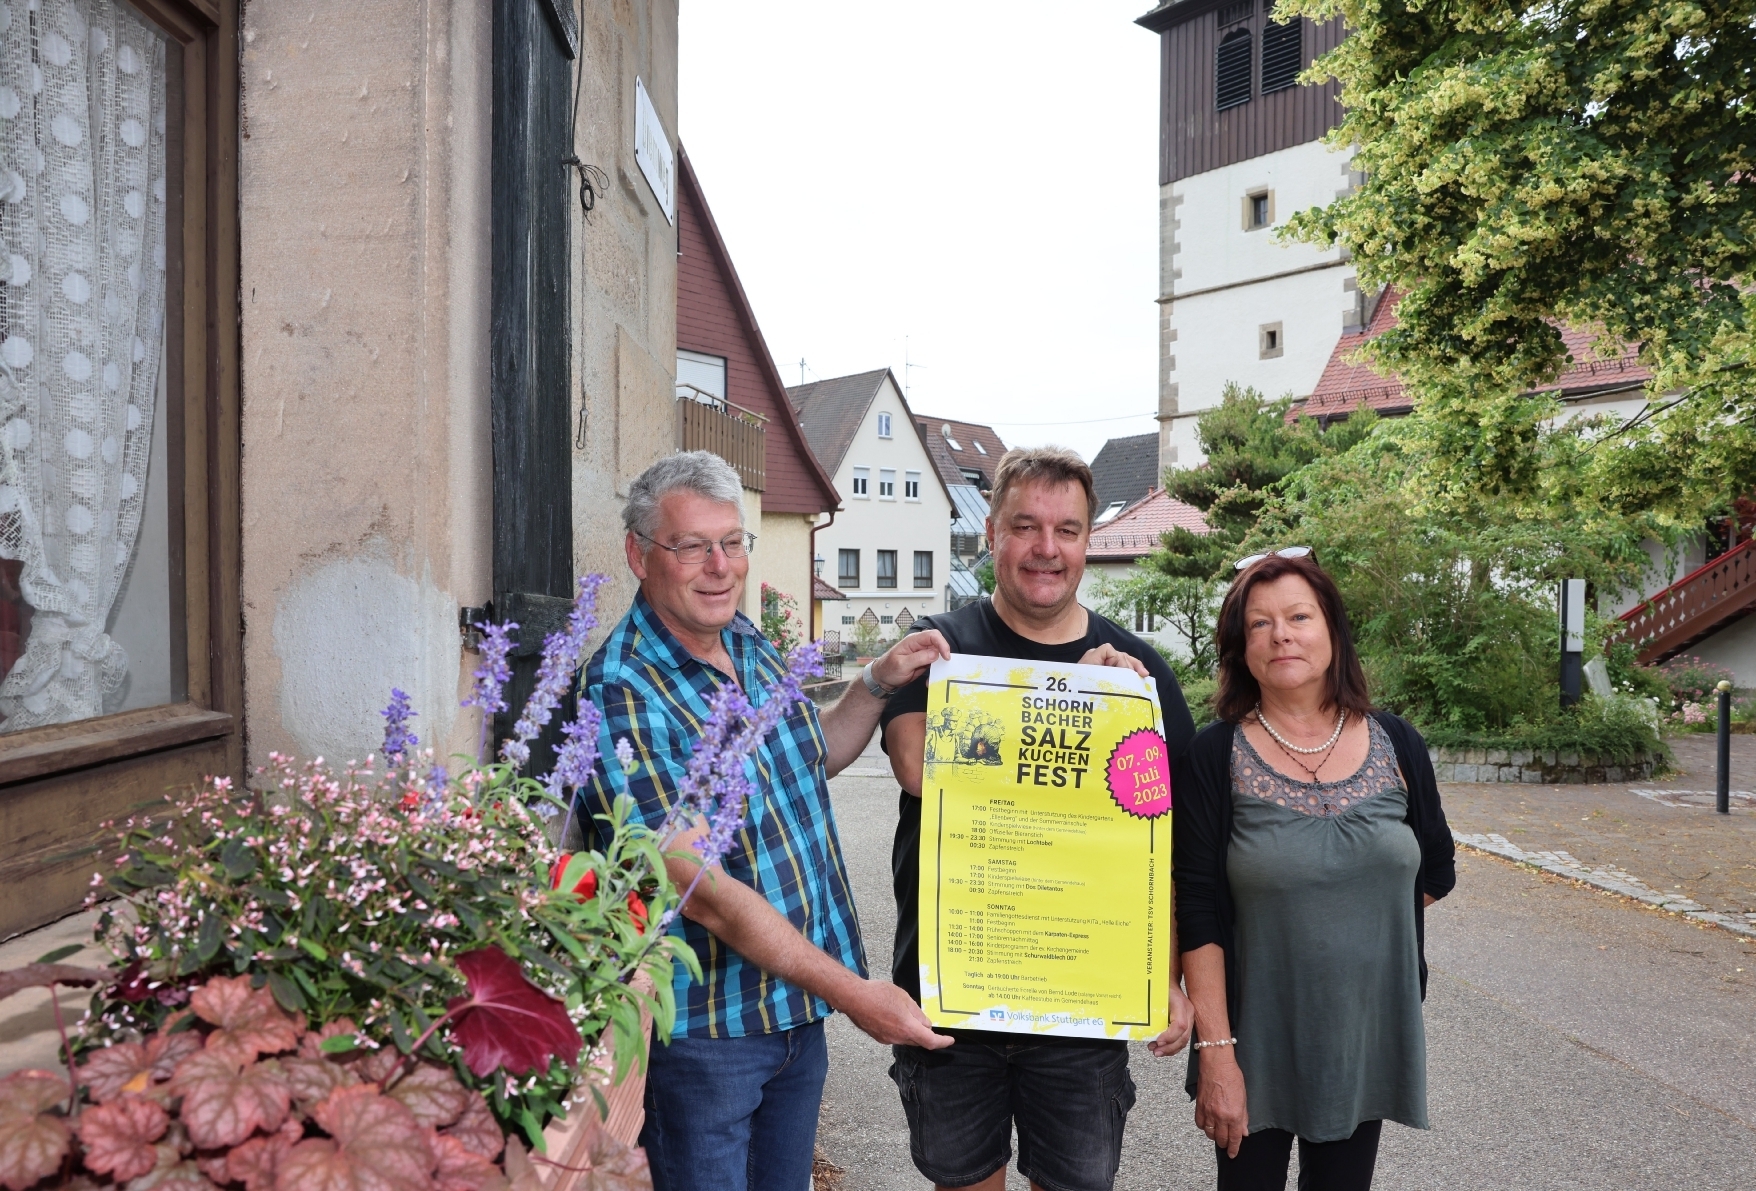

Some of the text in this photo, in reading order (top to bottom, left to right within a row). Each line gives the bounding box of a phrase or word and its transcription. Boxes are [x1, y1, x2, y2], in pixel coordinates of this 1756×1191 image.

[1046, 677, 1072, 692] 26.
[1022, 697, 1093, 714] SCHORN
[1022, 711, 1092, 728] BACHER
[1021, 726, 1091, 751] SALZ
[1019, 748, 1089, 765] KUCHEN
[1017, 764, 1087, 789] FEST
[1133, 766, 1160, 788] Juli
[1134, 784, 1168, 806] 2023
[1007, 1011, 1050, 1022] Volksbank
[1052, 1015, 1090, 1026] Stuttgart
